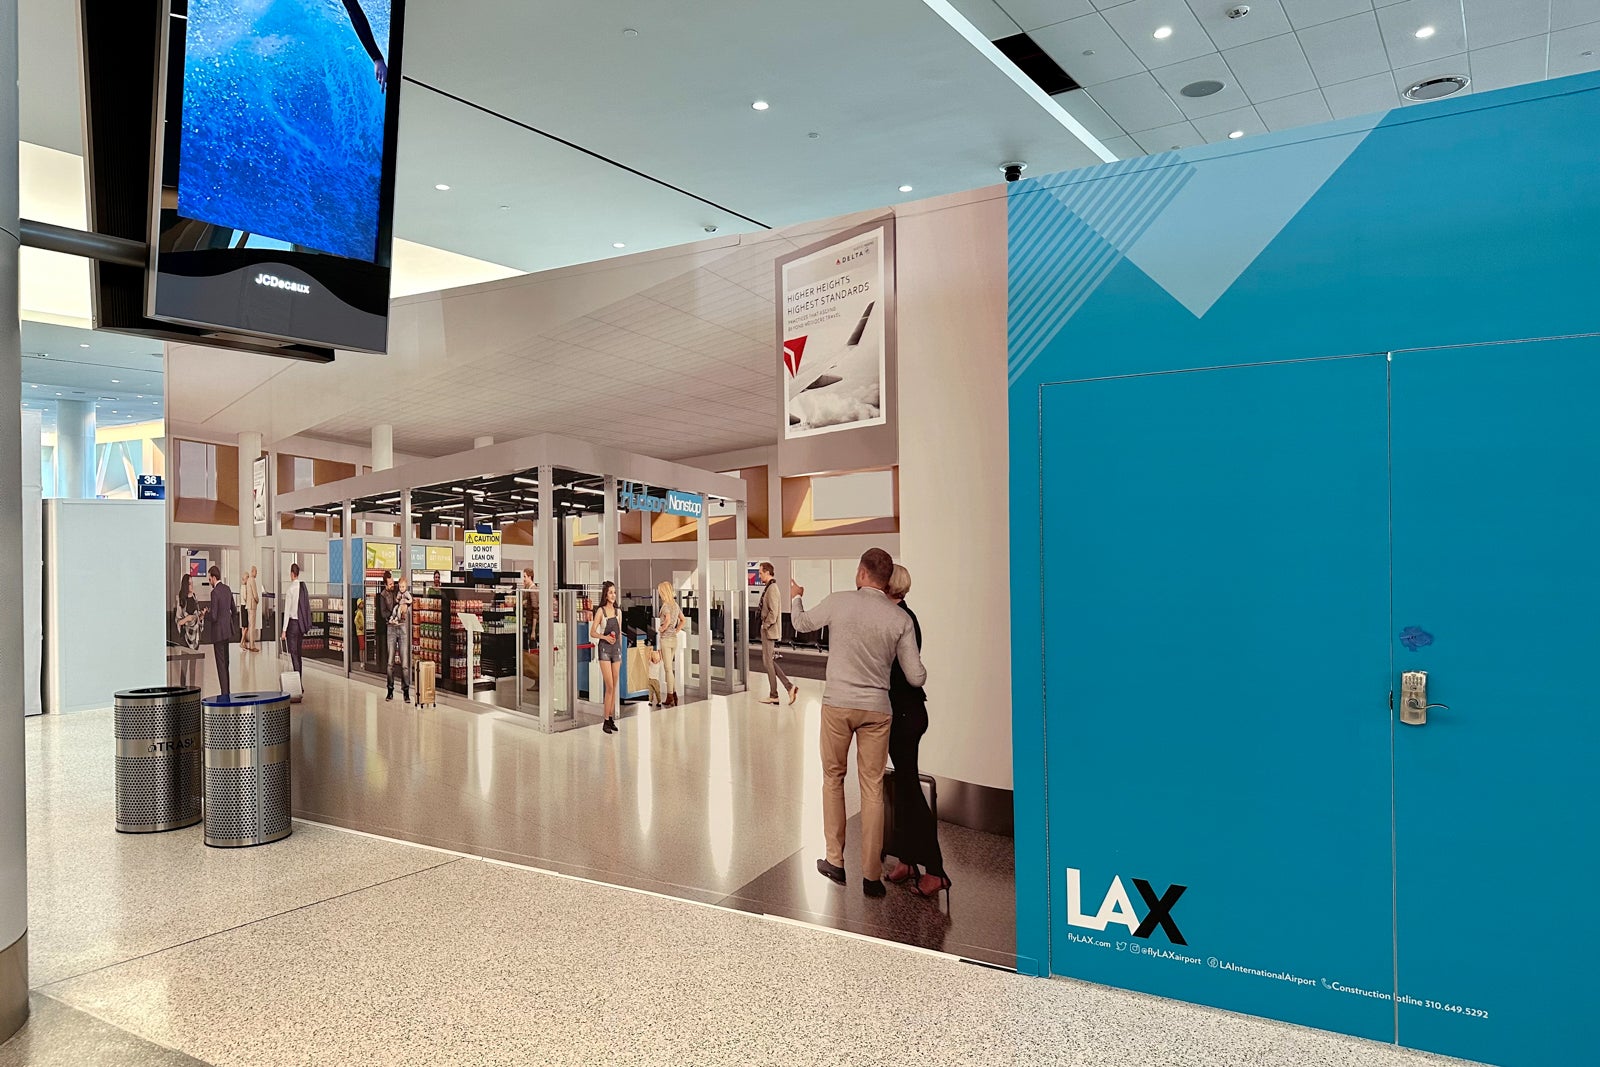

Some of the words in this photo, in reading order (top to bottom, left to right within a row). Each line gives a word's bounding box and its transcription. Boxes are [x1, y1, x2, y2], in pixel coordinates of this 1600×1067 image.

[842, 251, 864, 263] DELTA
[255, 273, 310, 294] JCDecaux
[788, 288, 815, 303] HIGHER
[816, 276, 851, 293] HEIGHTS
[788, 299, 820, 315] HIGHEST
[821, 282, 870, 305] STANDARDS
[144, 475, 157, 485] 36
[669, 494, 702, 516] Nonstop
[473, 535, 500, 543] CAUTION
[1067, 868, 1188, 946] LAX
[1068, 932, 1111, 948] flyLAX.com
[1141, 947, 1201, 965] @flyLAXairport
[1219, 960, 1316, 986] LAInternationalAirport
[1332, 981, 1391, 1001] Construction
[1425, 1000, 1489, 1019] 310.649.5292
